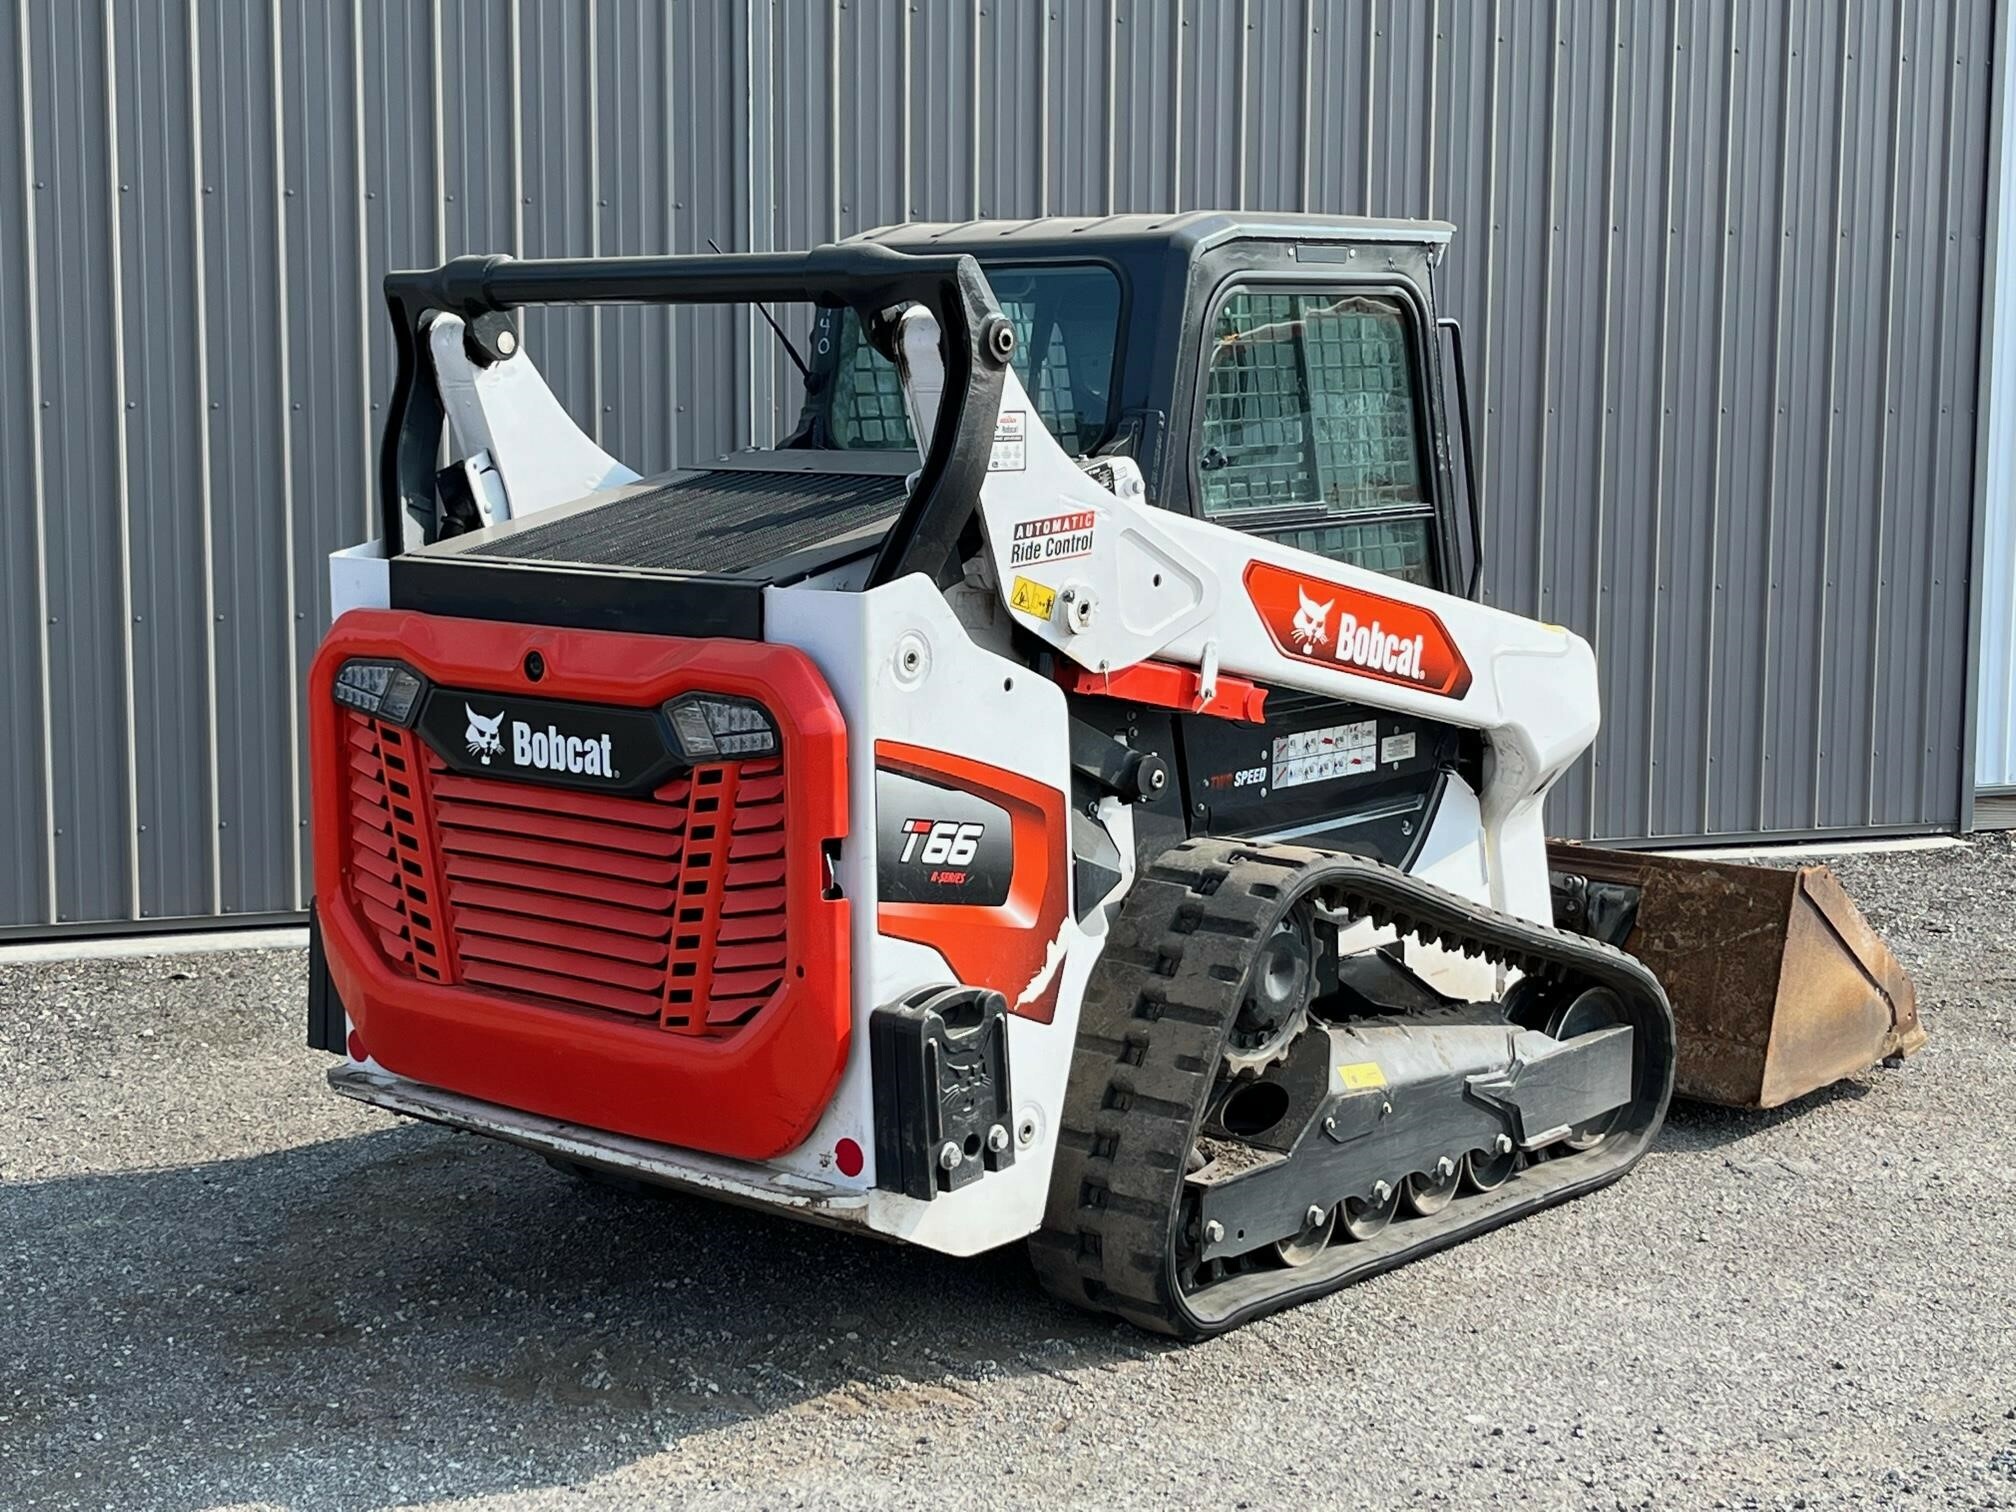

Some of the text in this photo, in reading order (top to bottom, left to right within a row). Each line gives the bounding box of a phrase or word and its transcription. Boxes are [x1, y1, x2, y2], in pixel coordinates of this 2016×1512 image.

[1011, 530, 1093, 563] Ride Control
[1015, 513, 1093, 539] AUTOMATIC
[1335, 612, 1424, 680] Bobcat
[512, 720, 613, 778] Bobcat
[1233, 767, 1267, 787] SPEED
[899, 818, 985, 867] T66
